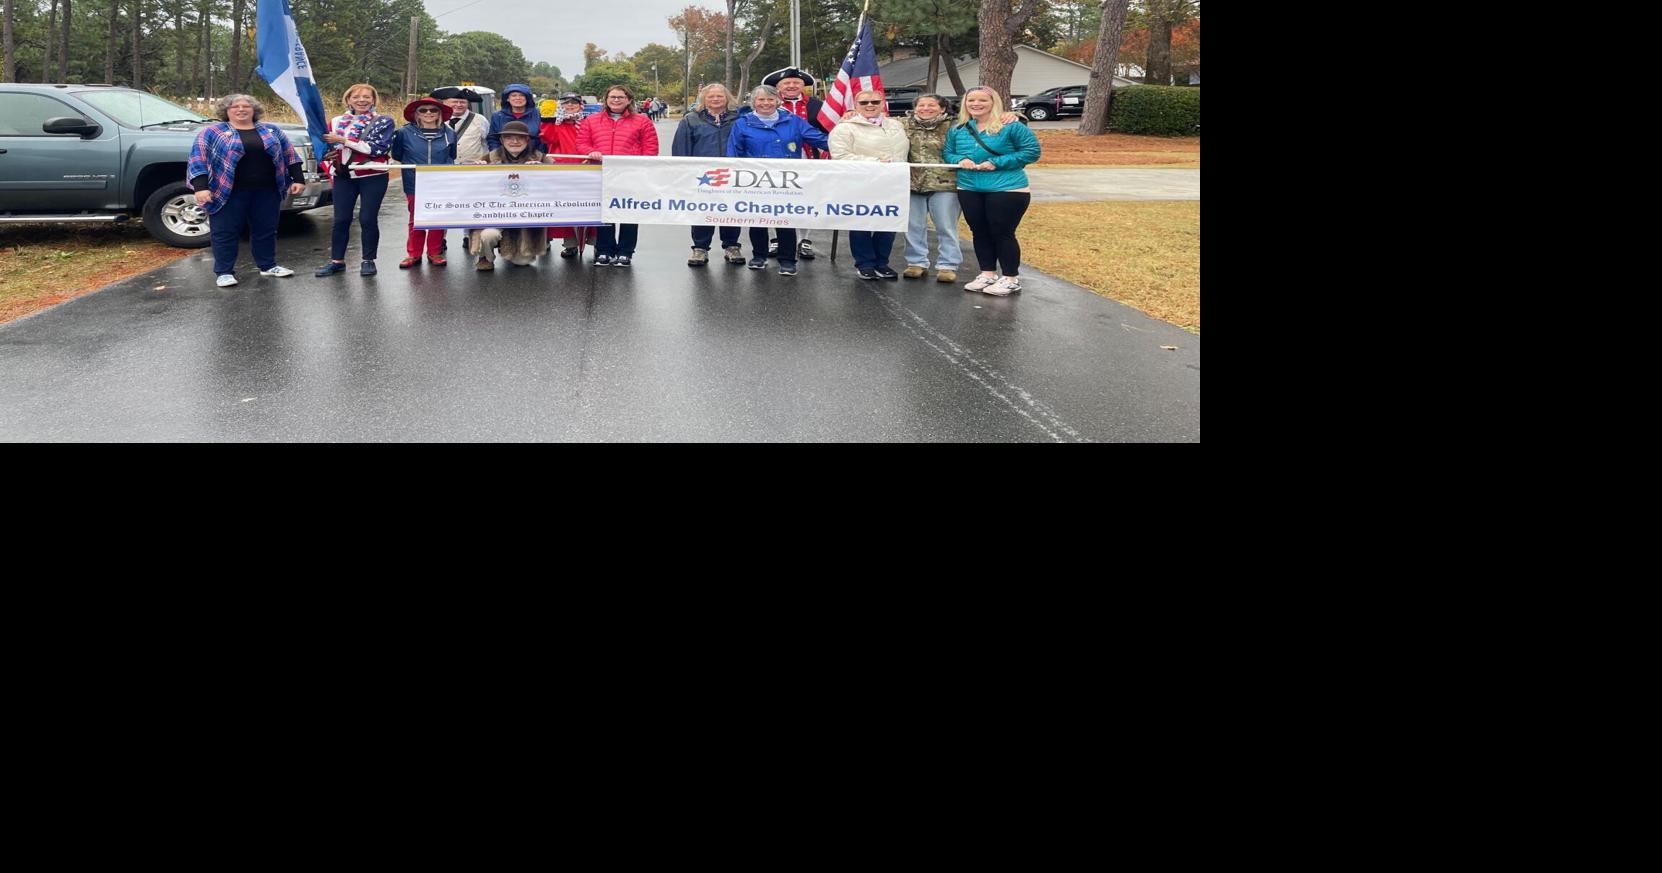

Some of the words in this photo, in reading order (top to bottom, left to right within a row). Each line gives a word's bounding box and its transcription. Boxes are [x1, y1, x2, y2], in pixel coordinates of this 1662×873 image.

[733, 170, 803, 190] DAR
[424, 201, 442, 209] The
[472, 201, 486, 209] Of
[488, 201, 507, 209] The
[554, 200, 602, 208] Revolution
[609, 198, 662, 211] Alfred
[668, 199, 728, 213] Moore
[734, 200, 819, 217] Chapter,
[826, 203, 899, 217] NSDAR
[472, 211, 517, 219] Sandhills
[705, 215, 755, 224] Southern
[759, 217, 790, 226] Pines
